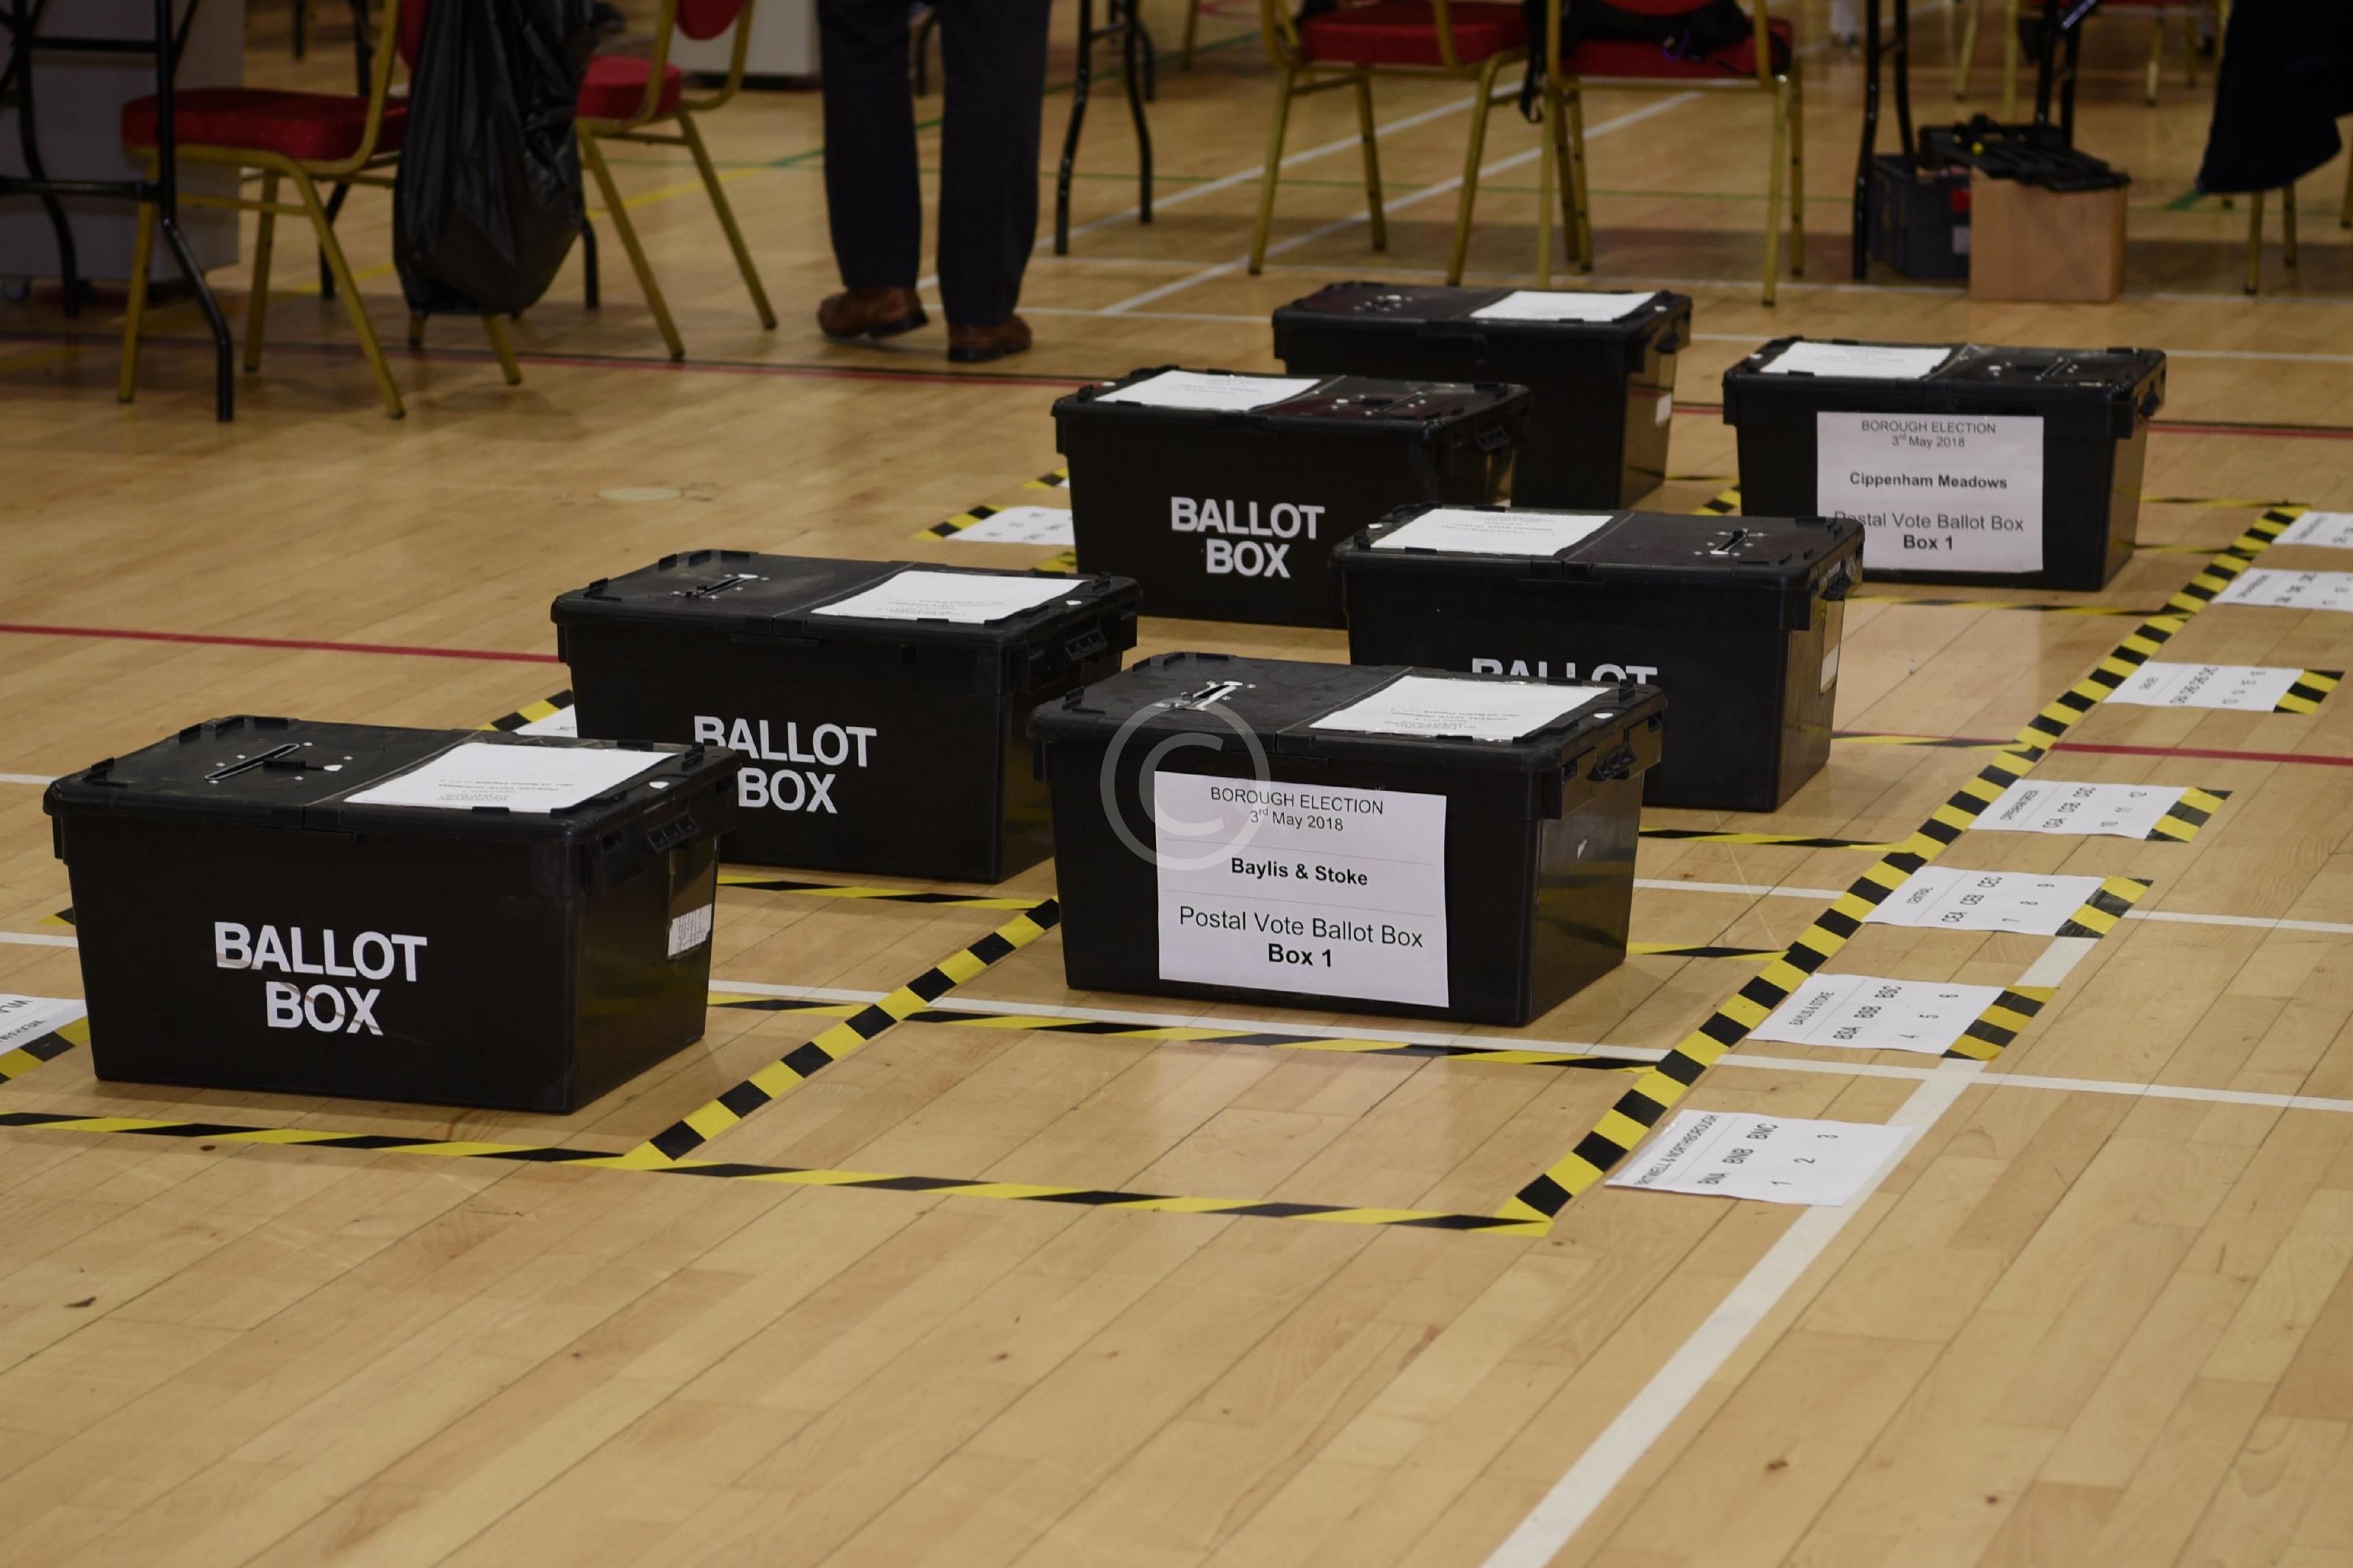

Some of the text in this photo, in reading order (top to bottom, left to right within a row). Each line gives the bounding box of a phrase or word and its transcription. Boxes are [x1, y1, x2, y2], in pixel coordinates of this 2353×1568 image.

[1861, 420, 1996, 434] BOROUGH ELECTION
[1909, 435, 1934, 448] May
[1936, 436, 1965, 448] 2018
[1849, 471, 2008, 489] Cippenham Meadows
[1171, 495, 1326, 540] BALLOT
[1891, 512, 1932, 529] Vote
[1938, 513, 1985, 531] Ballot
[1990, 515, 2024, 531] Box
[1206, 538, 1291, 579] BOX
[1903, 534, 1954, 550] Box 1
[694, 715, 877, 768] BALLOT
[737, 767, 838, 815] BOX
[1210, 786, 1384, 815] BOROUGH ELECTION
[1249, 807, 1344, 831] 3rd May 2018
[1231, 856, 1368, 887] Baylis & Stoke
[1179, 906, 1424, 948] Postal Vote Ballot Box
[215, 921, 428, 983] BALLOT
[1268, 942, 1332, 967] Box 1
[265, 981, 384, 1037] BOX
[1832, 985, 1903, 1040] BSA BSB BSC
[1664, 1114, 1721, 1159] NORTHBOROUGH
[1696, 1123, 1779, 1186] BNA BNB BNC
[1793, 1156, 1816, 1165] 2
[1816, 1132, 1839, 1141] 3
